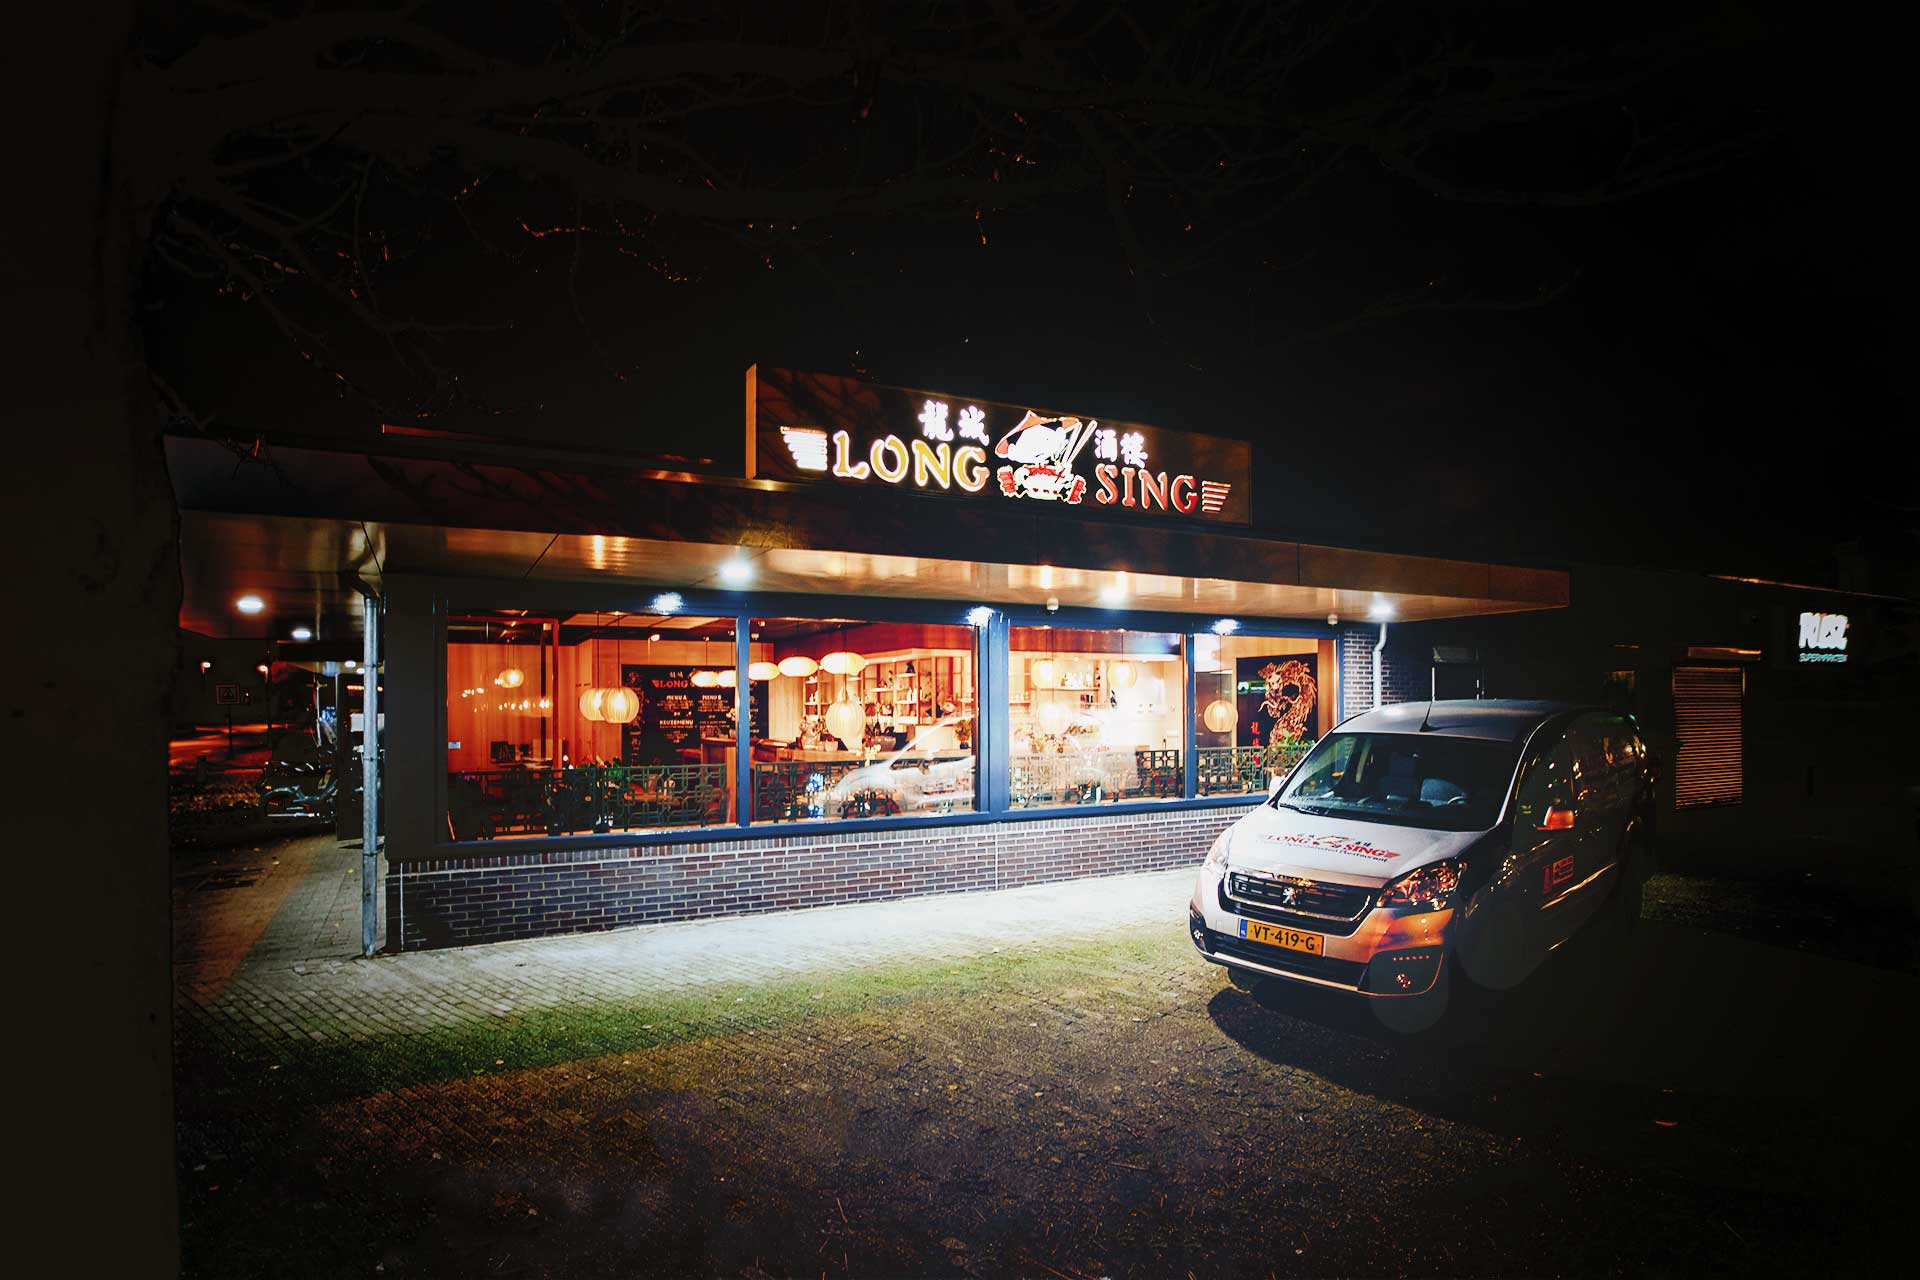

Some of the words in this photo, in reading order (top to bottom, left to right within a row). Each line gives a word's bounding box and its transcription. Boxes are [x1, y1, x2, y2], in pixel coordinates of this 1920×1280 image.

[832, 429, 991, 492] LONG
[1095, 463, 1199, 512] SING
[1265, 834, 1311, 844] LONG
[1343, 844, 1386, 857] SING
[1253, 924, 1316, 951] VT-419-G
